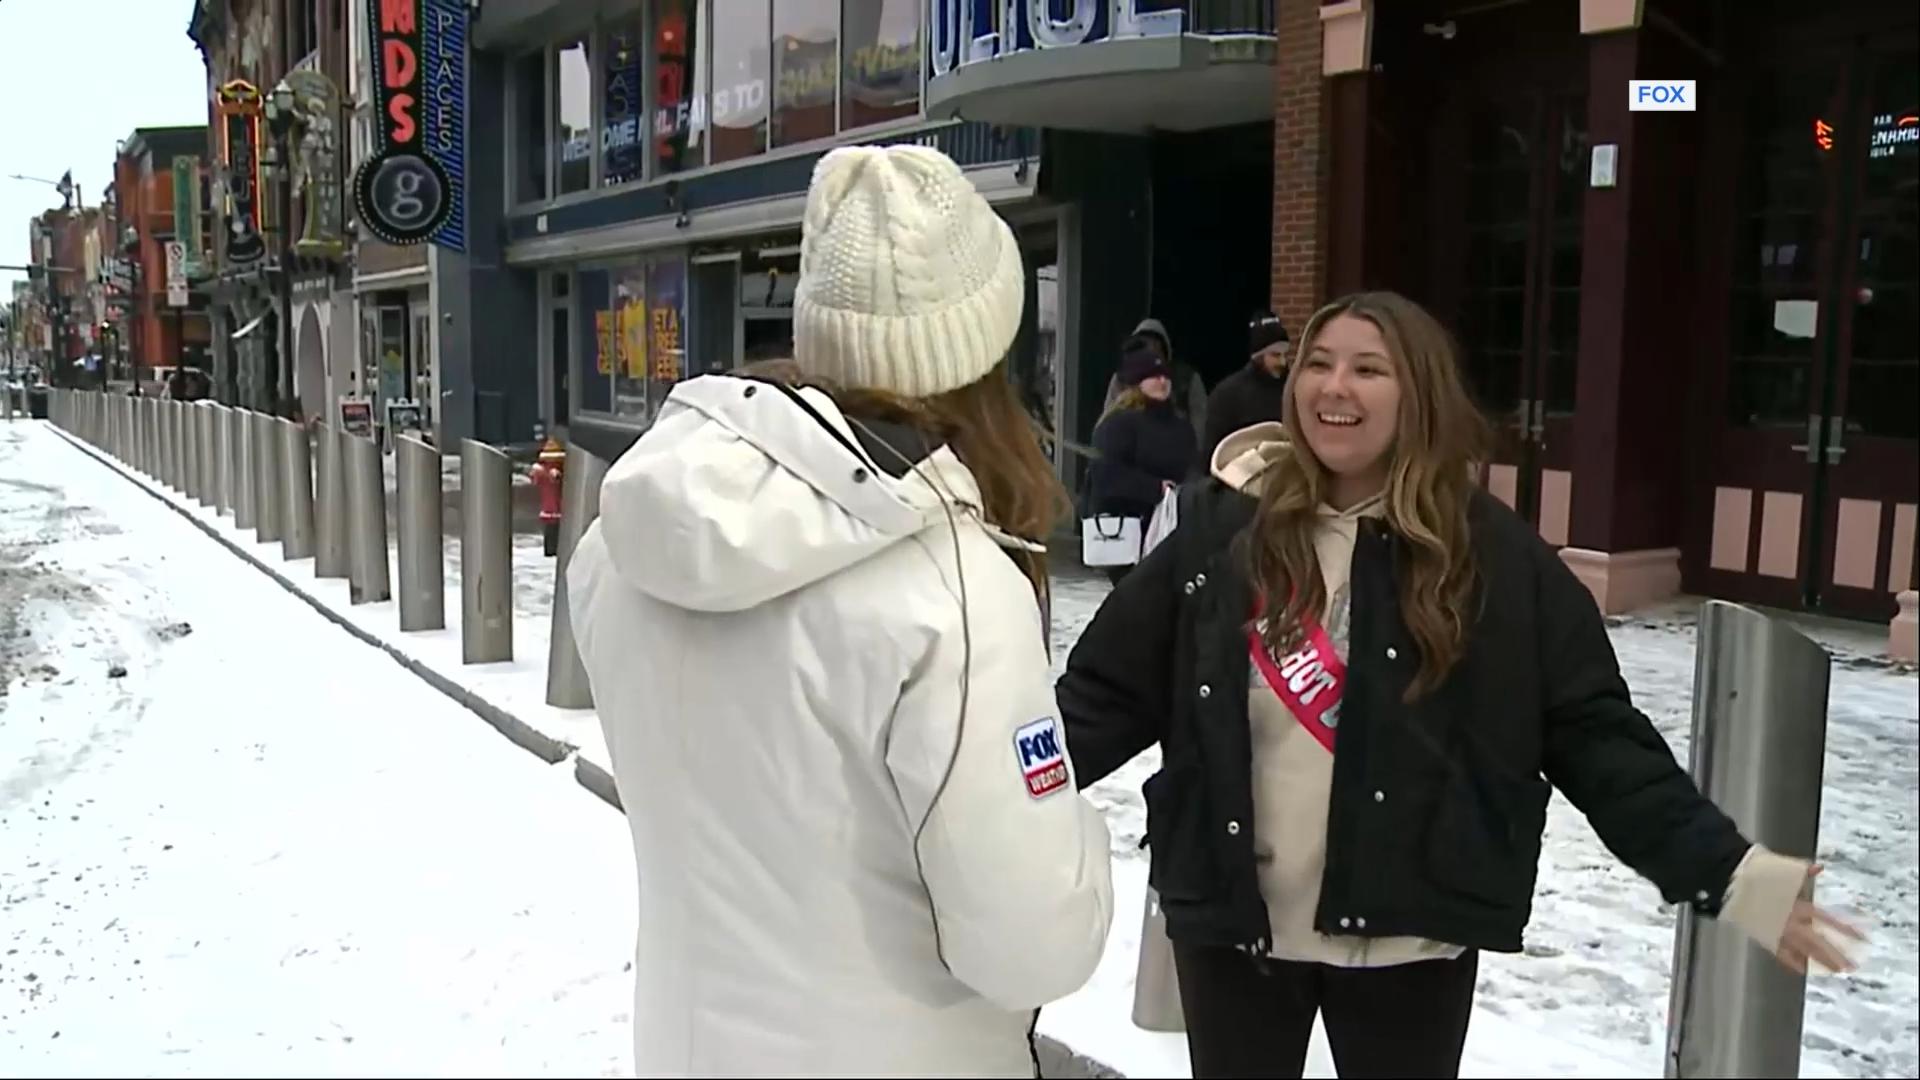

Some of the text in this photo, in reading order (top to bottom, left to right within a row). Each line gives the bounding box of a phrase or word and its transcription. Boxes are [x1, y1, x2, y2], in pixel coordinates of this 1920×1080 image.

[436, 13, 454, 152] PLACES
[562, 119, 636, 162] WELOME
[734, 79, 765, 112] TO
[1018, 727, 1060, 767] FOX
